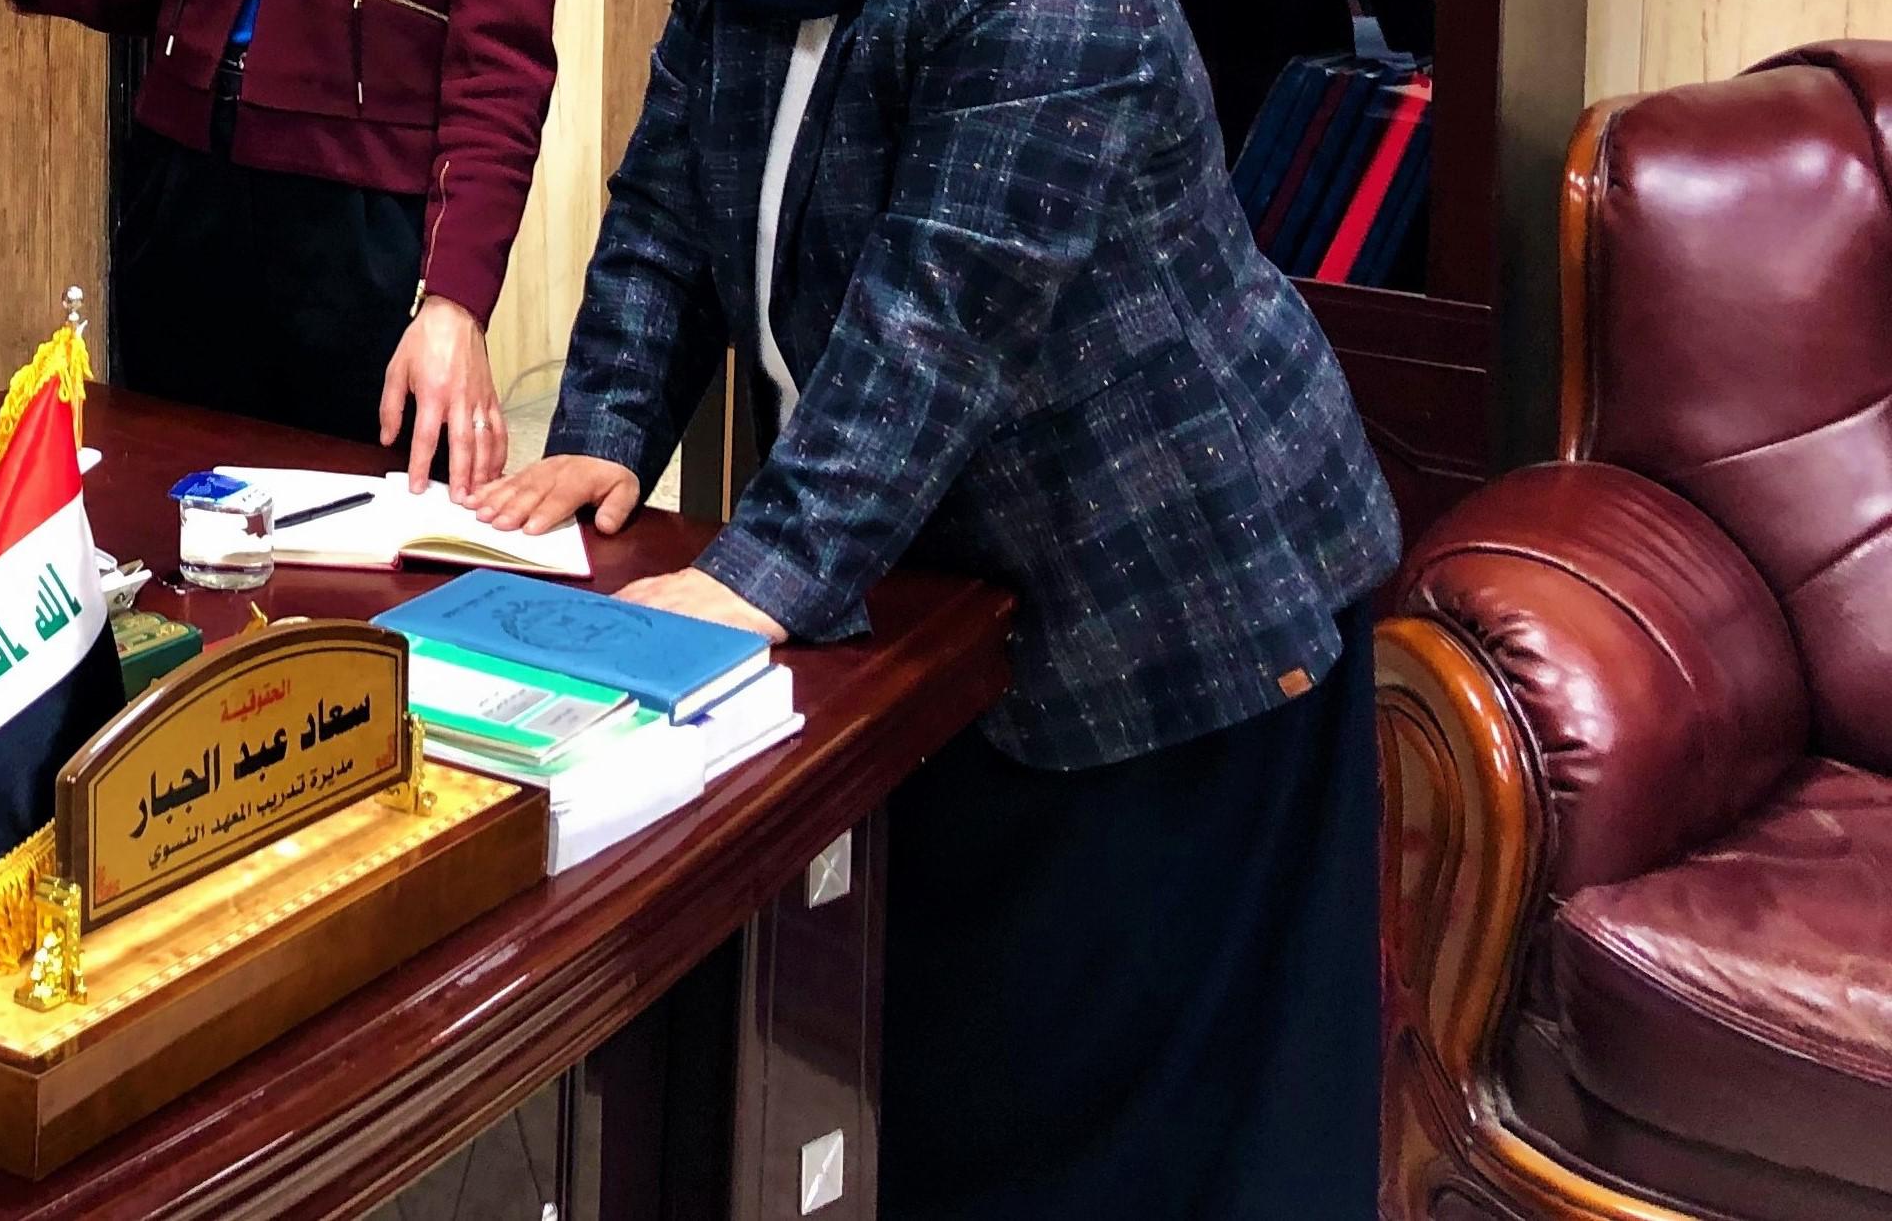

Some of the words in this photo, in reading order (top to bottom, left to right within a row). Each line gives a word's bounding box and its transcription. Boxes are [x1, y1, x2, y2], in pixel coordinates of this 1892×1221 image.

[34, 561, 84, 643] الله
[299, 692, 372, 752] سعاد
[232, 726, 289, 784] عبد
[308, 757, 355, 792] مديرة
[128, 741, 223, 840] الجبار
[209, 800, 253, 835] المعهد
[256, 772, 307, 819] تدريب
